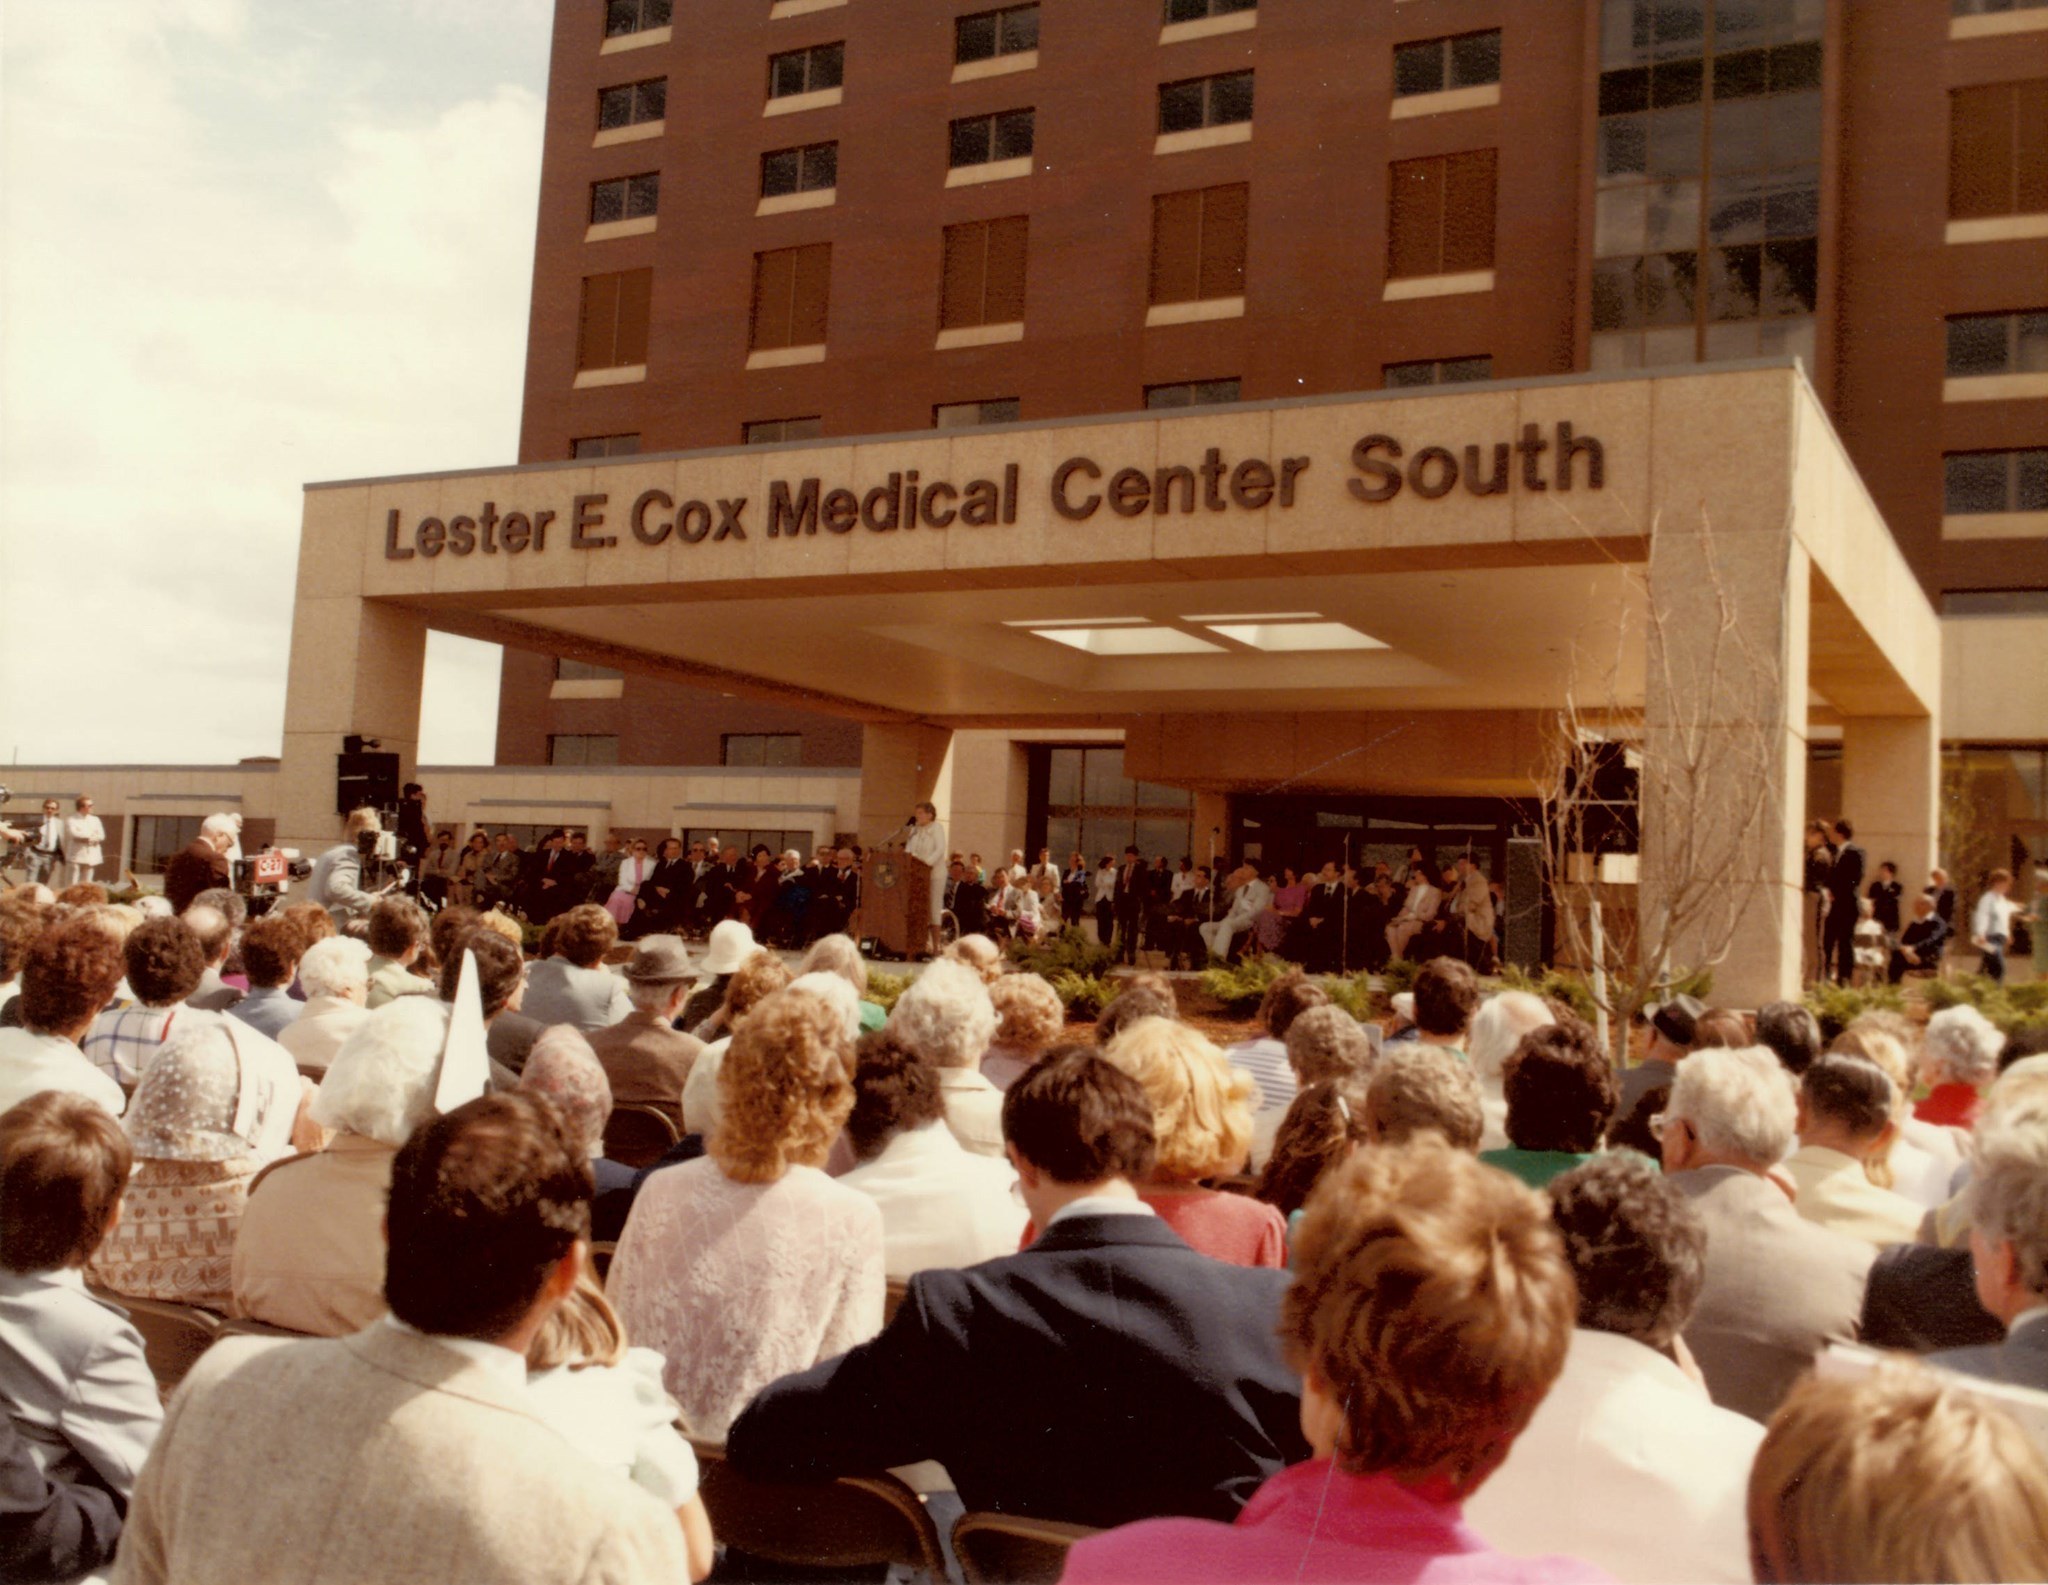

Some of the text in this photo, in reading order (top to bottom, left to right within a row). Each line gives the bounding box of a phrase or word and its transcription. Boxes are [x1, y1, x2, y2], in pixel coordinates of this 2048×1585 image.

[385, 420, 1604, 560] Lester E. Cox Medical Center South
